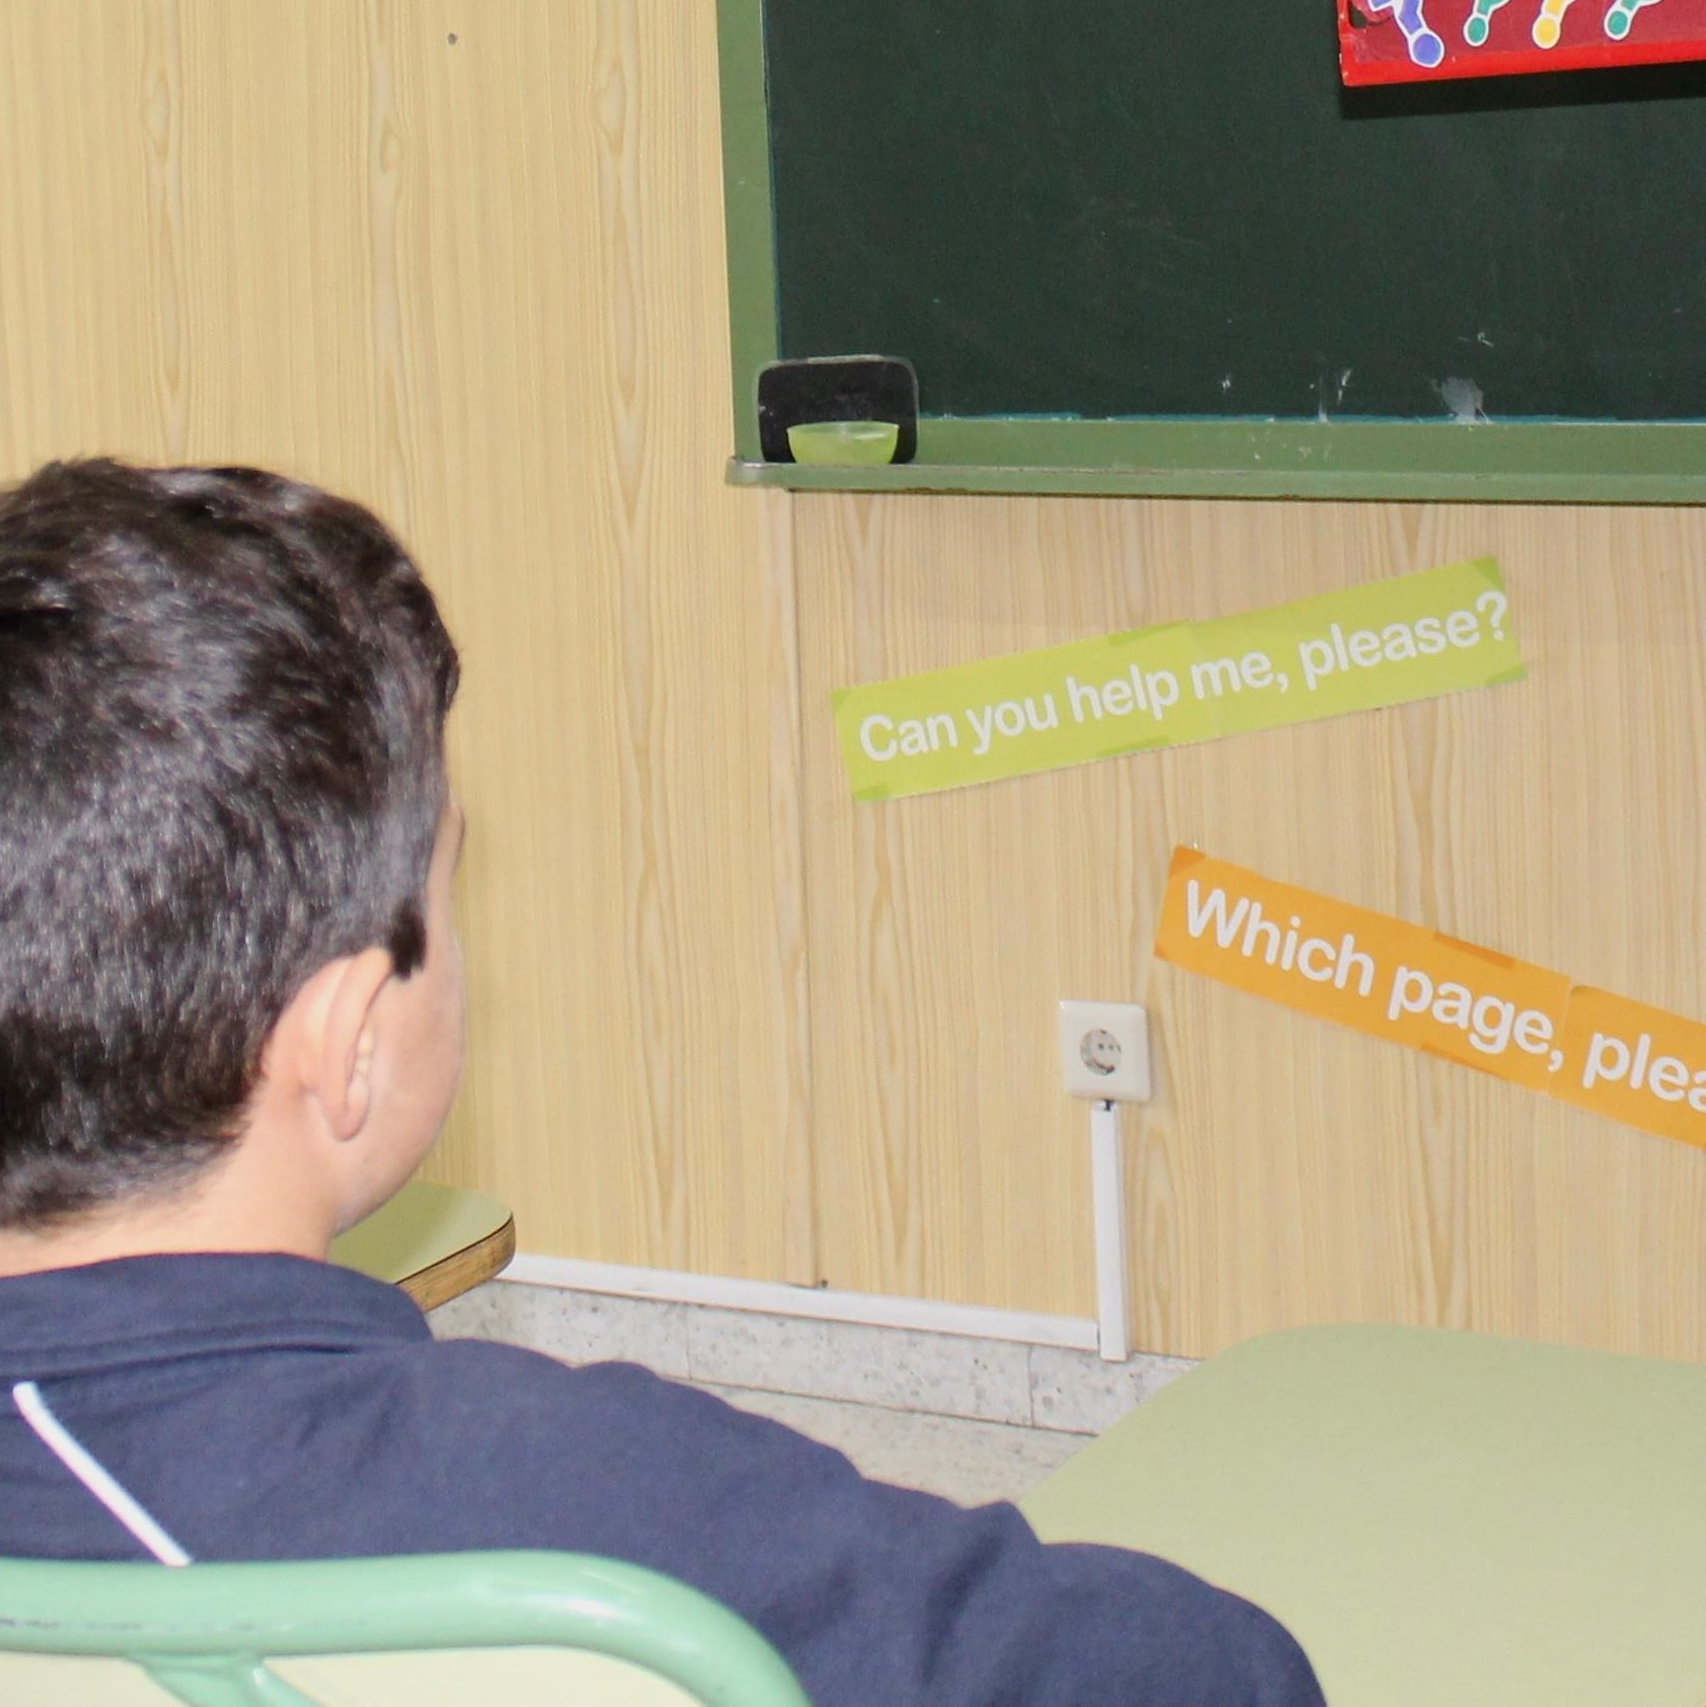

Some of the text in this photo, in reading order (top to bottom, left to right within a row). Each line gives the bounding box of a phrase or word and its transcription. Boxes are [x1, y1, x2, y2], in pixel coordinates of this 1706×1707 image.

[859, 590, 1508, 762] Can you help me, please?
[1185, 878, 1375, 997] Which
[1387, 965, 1565, 1073] page,
